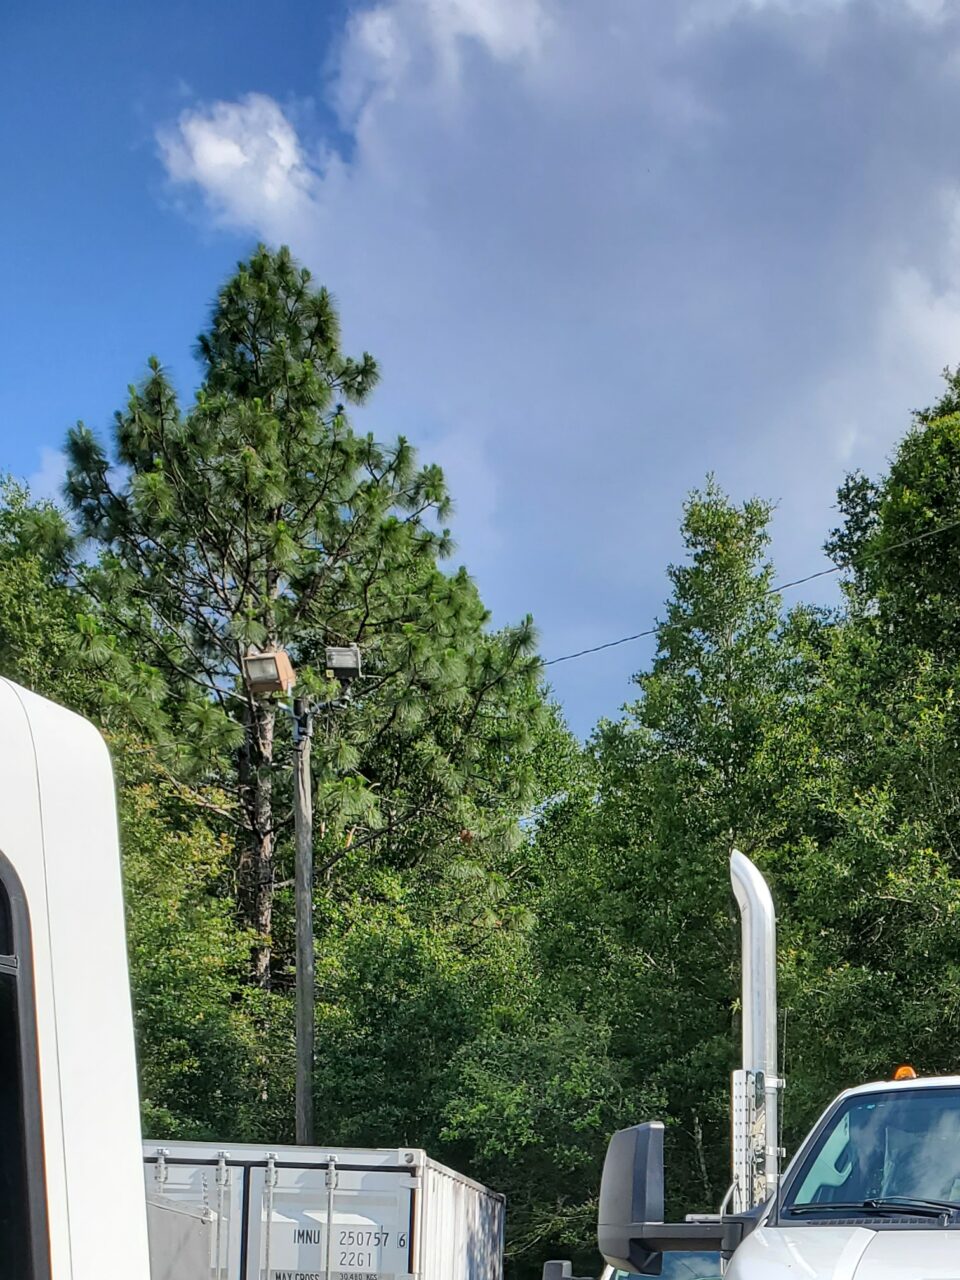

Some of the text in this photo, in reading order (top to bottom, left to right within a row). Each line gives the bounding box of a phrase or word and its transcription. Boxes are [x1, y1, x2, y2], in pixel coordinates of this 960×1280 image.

[294, 1229, 407, 1248] IMNU 250757 6
[339, 1251, 372, 1267] 22G1
